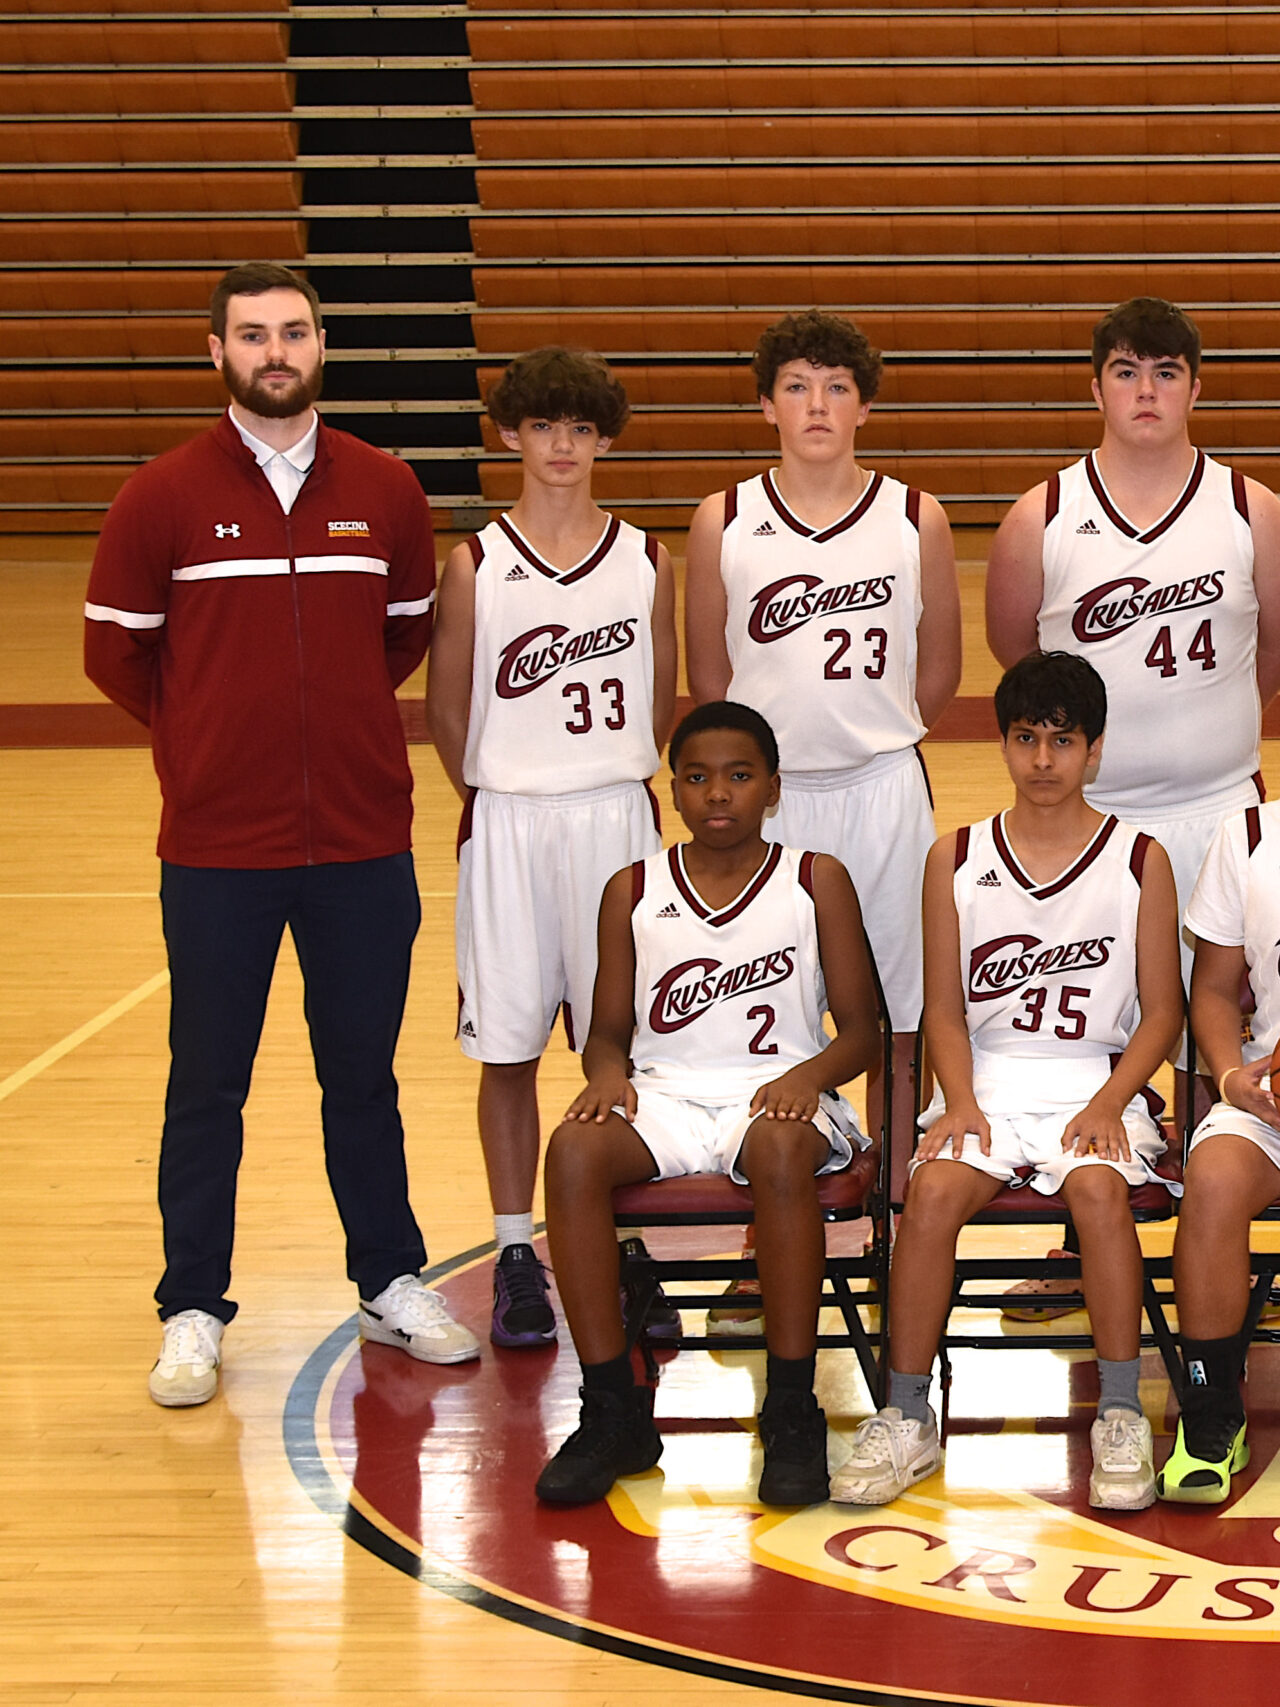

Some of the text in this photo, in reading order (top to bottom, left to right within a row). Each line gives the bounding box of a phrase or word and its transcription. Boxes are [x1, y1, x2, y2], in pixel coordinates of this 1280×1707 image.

[748, 574, 896, 644] CRUSADERS
[1071, 570, 1225, 643] CRUSADERS
[496, 617, 638, 699] CRUSADERS
[823, 628, 888, 680] 23
[1144, 618, 1217, 678] 44
[562, 678, 625, 735] 33
[648, 946, 797, 1035] CRUSADERS
[967, 934, 1117, 1003] CRUSADERS
[745, 1004, 779, 1056] 2
[1011, 985, 1092, 1040] 35
